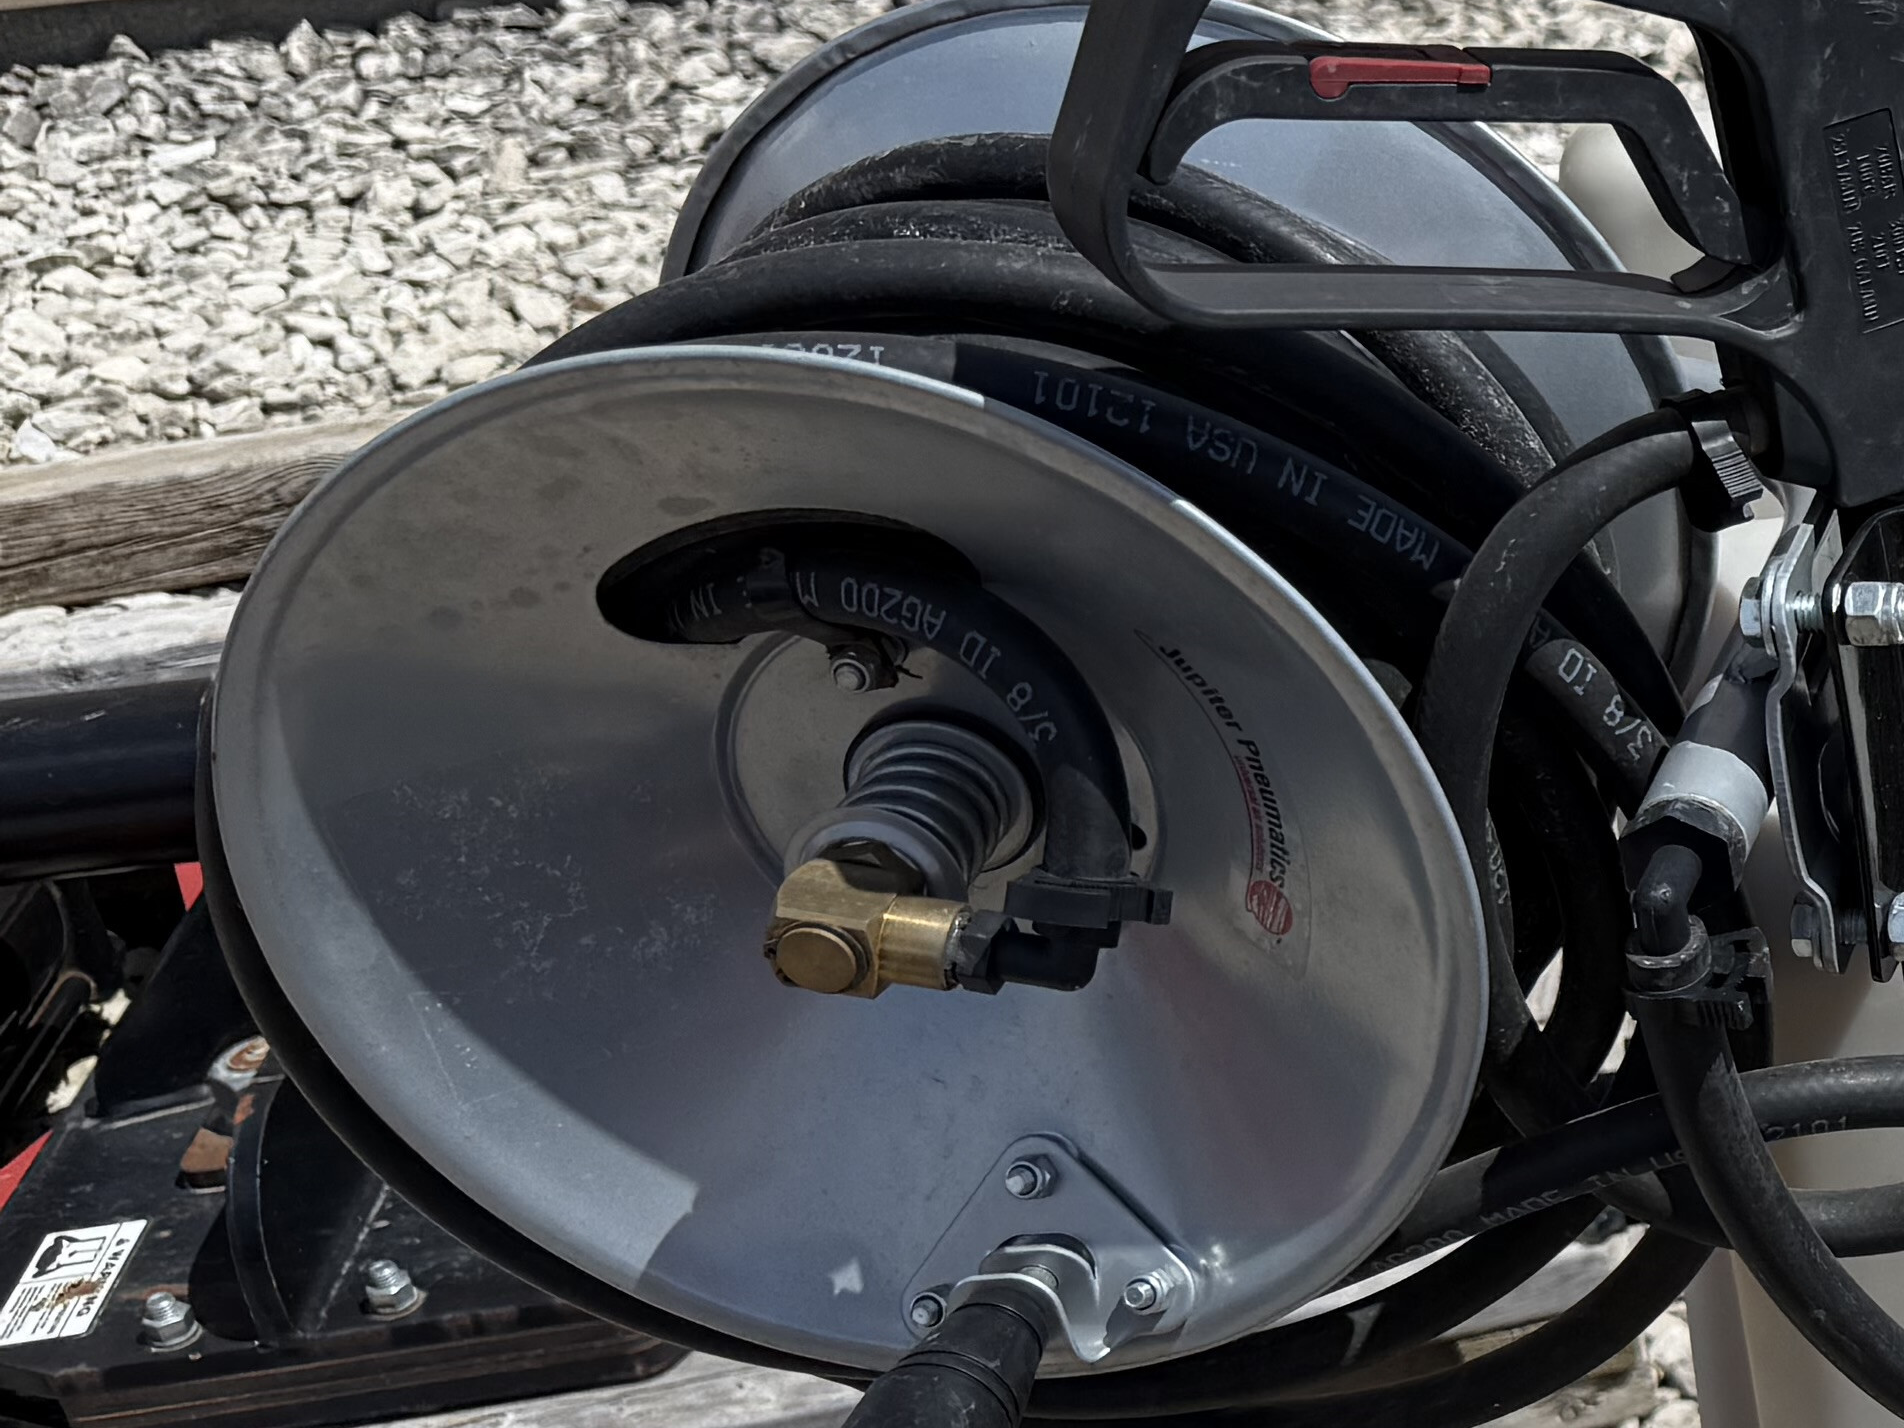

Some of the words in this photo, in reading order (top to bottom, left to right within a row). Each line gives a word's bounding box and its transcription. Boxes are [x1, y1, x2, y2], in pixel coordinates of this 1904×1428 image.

[1033, 370, 1157, 435] 12101
[1185, 413, 1259, 475] USA
[1277, 455, 1329, 508] IN
[1347, 492, 1440, 571] MADE
[840, 575, 947, 641] AG200
[959, 629, 1002, 680] ID
[1558, 647, 1598, 696] ID
[1603, 693, 1653, 762] 3/8
[1159, 645, 1243, 732] Jupiter
[1237, 738, 1291, 889] Pneumatics
